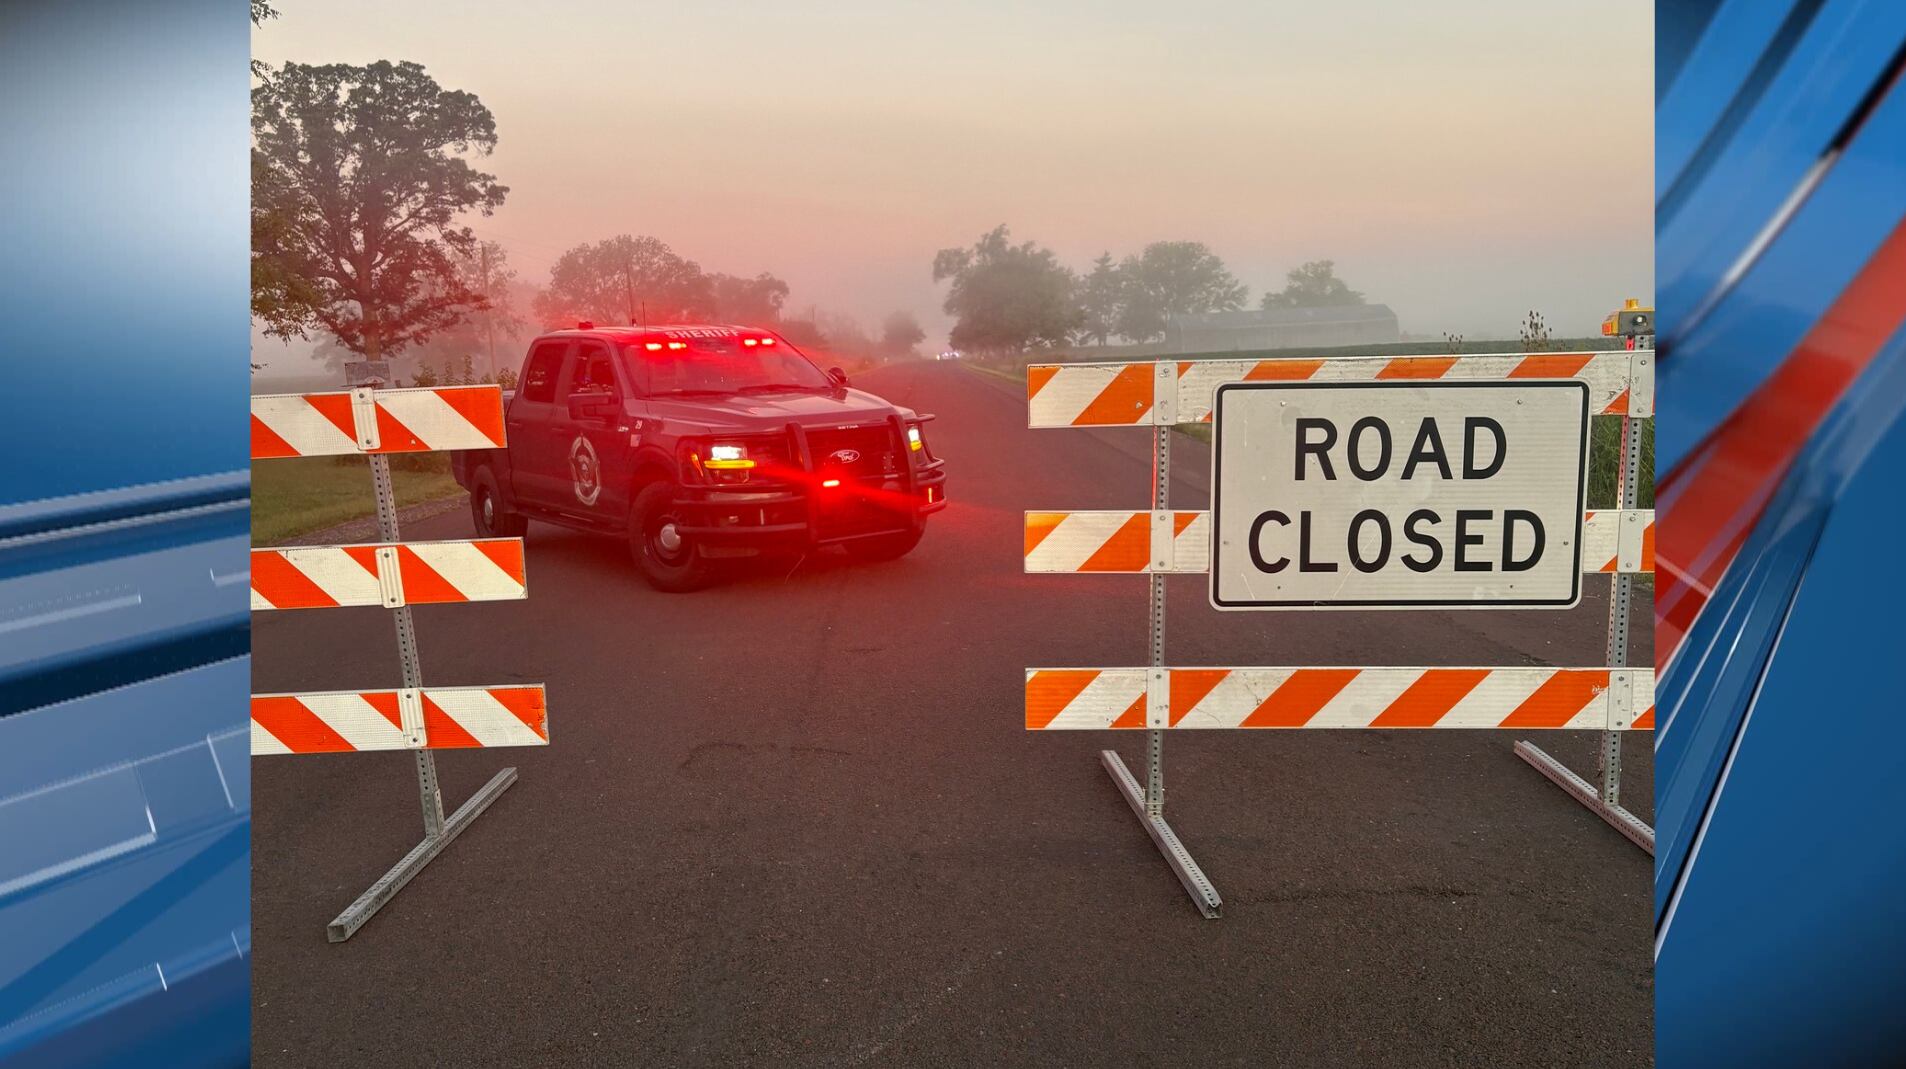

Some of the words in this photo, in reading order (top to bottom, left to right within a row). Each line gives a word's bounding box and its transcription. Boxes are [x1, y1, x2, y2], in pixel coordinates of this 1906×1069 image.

[664, 329, 740, 339] SHERIFF
[1295, 416, 1507, 481] ROAD
[1248, 509, 1546, 574] CLOSED
